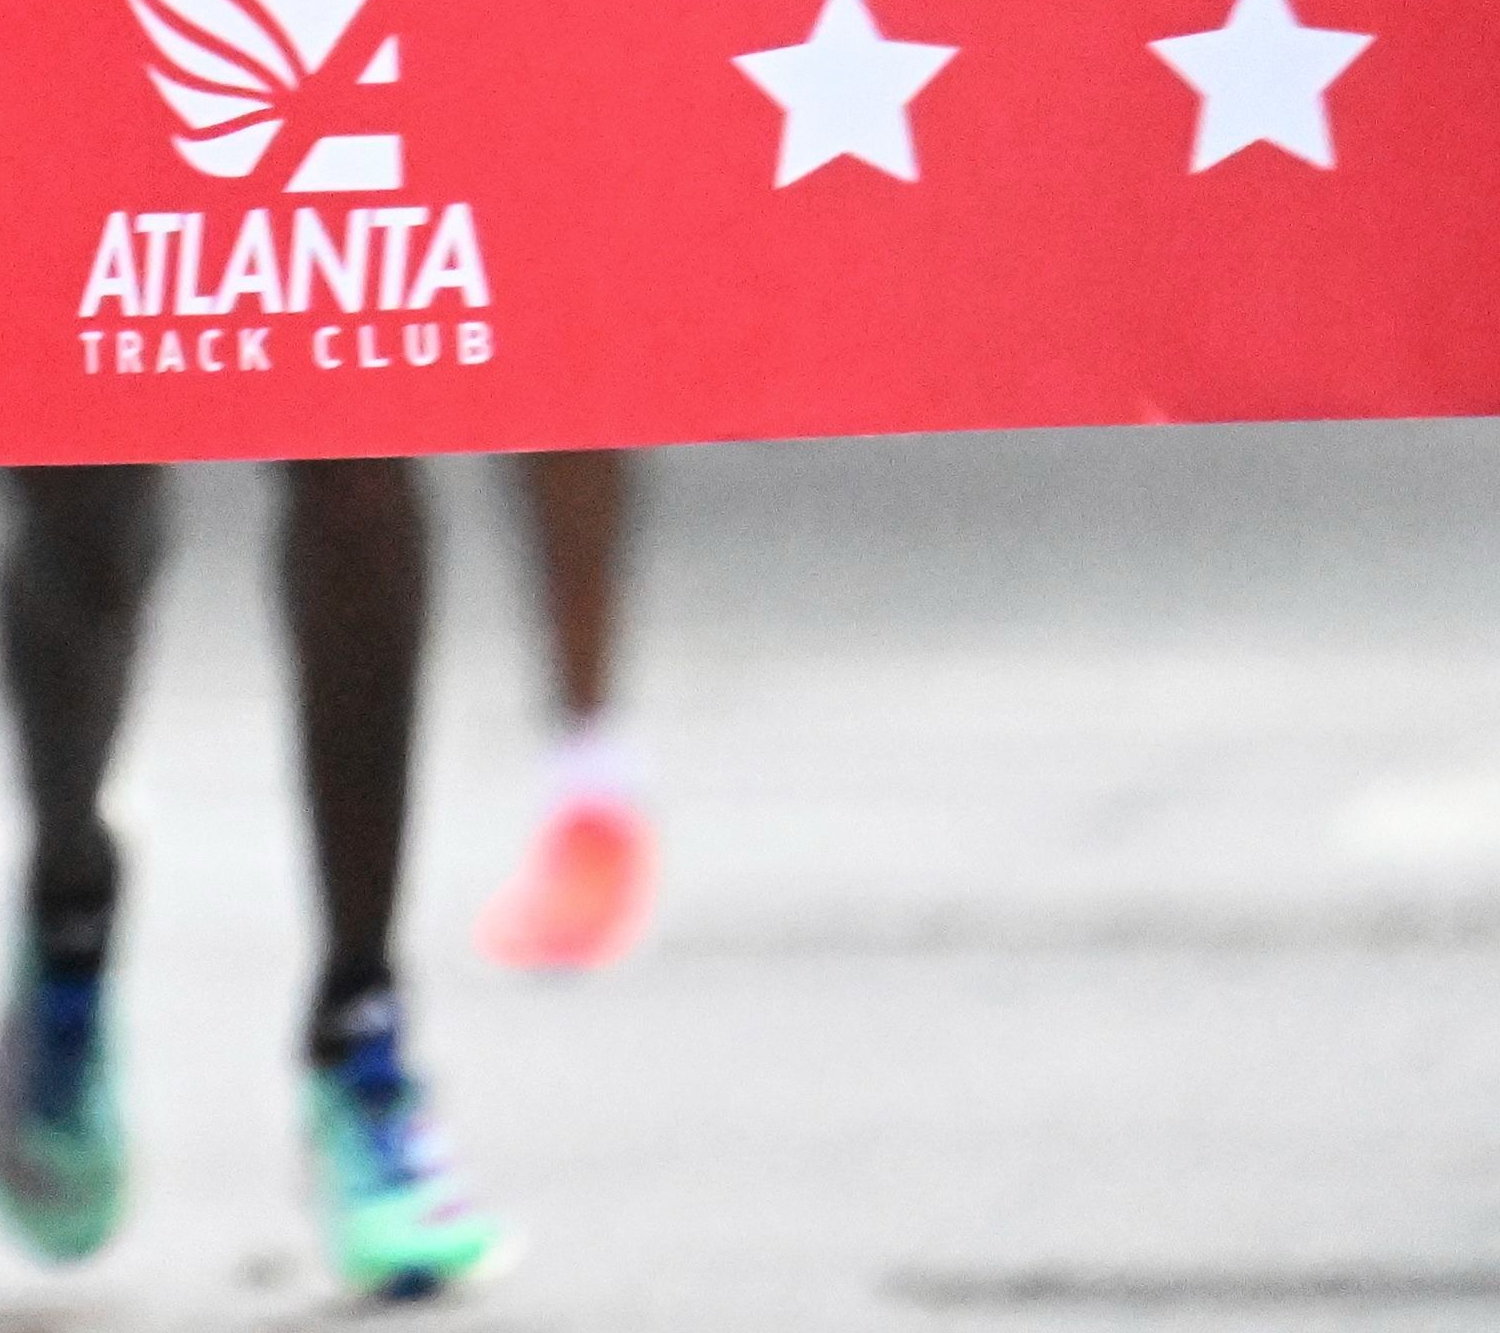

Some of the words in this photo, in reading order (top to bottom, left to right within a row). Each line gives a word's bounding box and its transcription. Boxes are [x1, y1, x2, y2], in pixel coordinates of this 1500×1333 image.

[78, 201, 490, 318] ATLANTA
[80, 328, 270, 375] TRACK
[312, 320, 493, 370] CLUB
